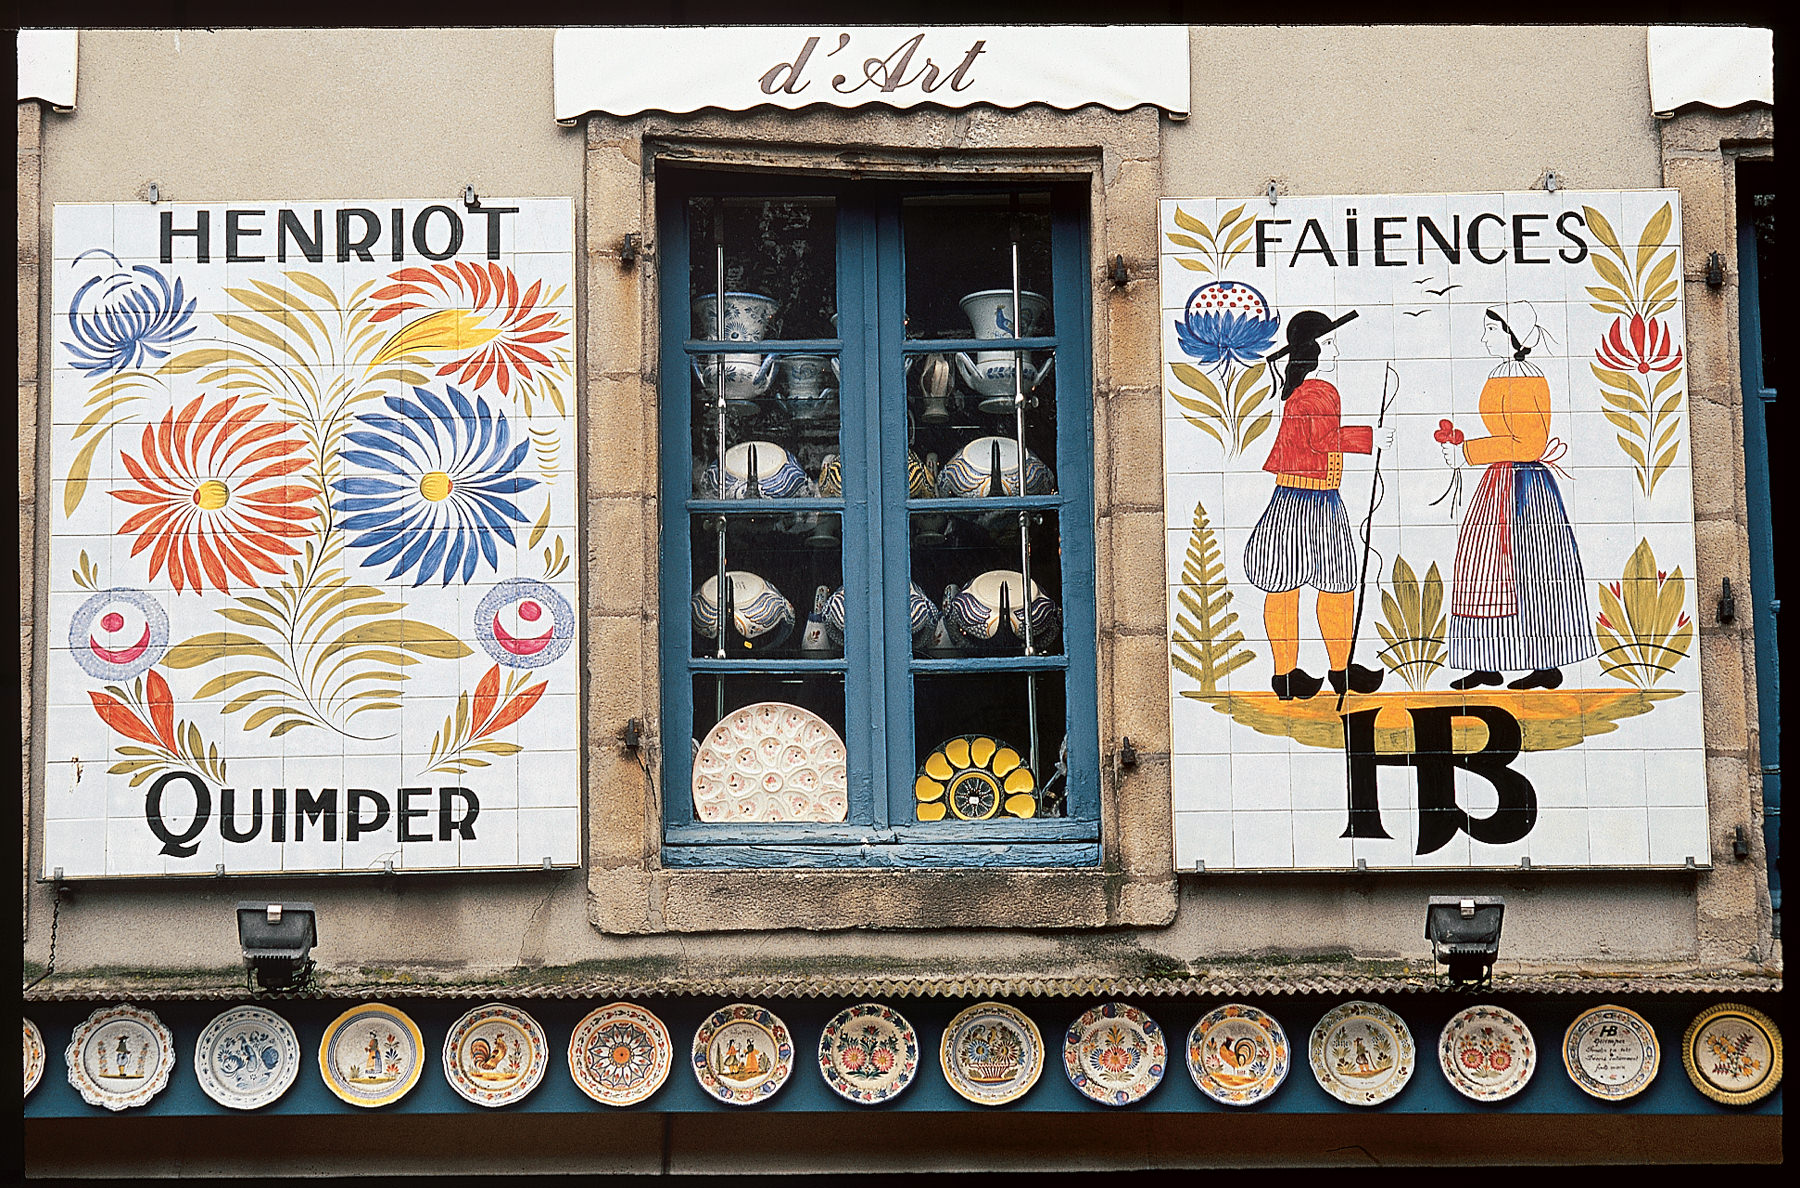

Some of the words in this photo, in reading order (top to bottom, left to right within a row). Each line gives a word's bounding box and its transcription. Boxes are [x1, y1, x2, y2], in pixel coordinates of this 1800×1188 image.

[757, 33, 986, 95] d'Art
[159, 205, 520, 264] HENRIOT
[1255, 208, 1589, 268] FAÏENCES
[1338, 704, 1538, 856] HB
[144, 770, 481, 859] QUIMPER
[1599, 1025, 1618, 1037] HB
